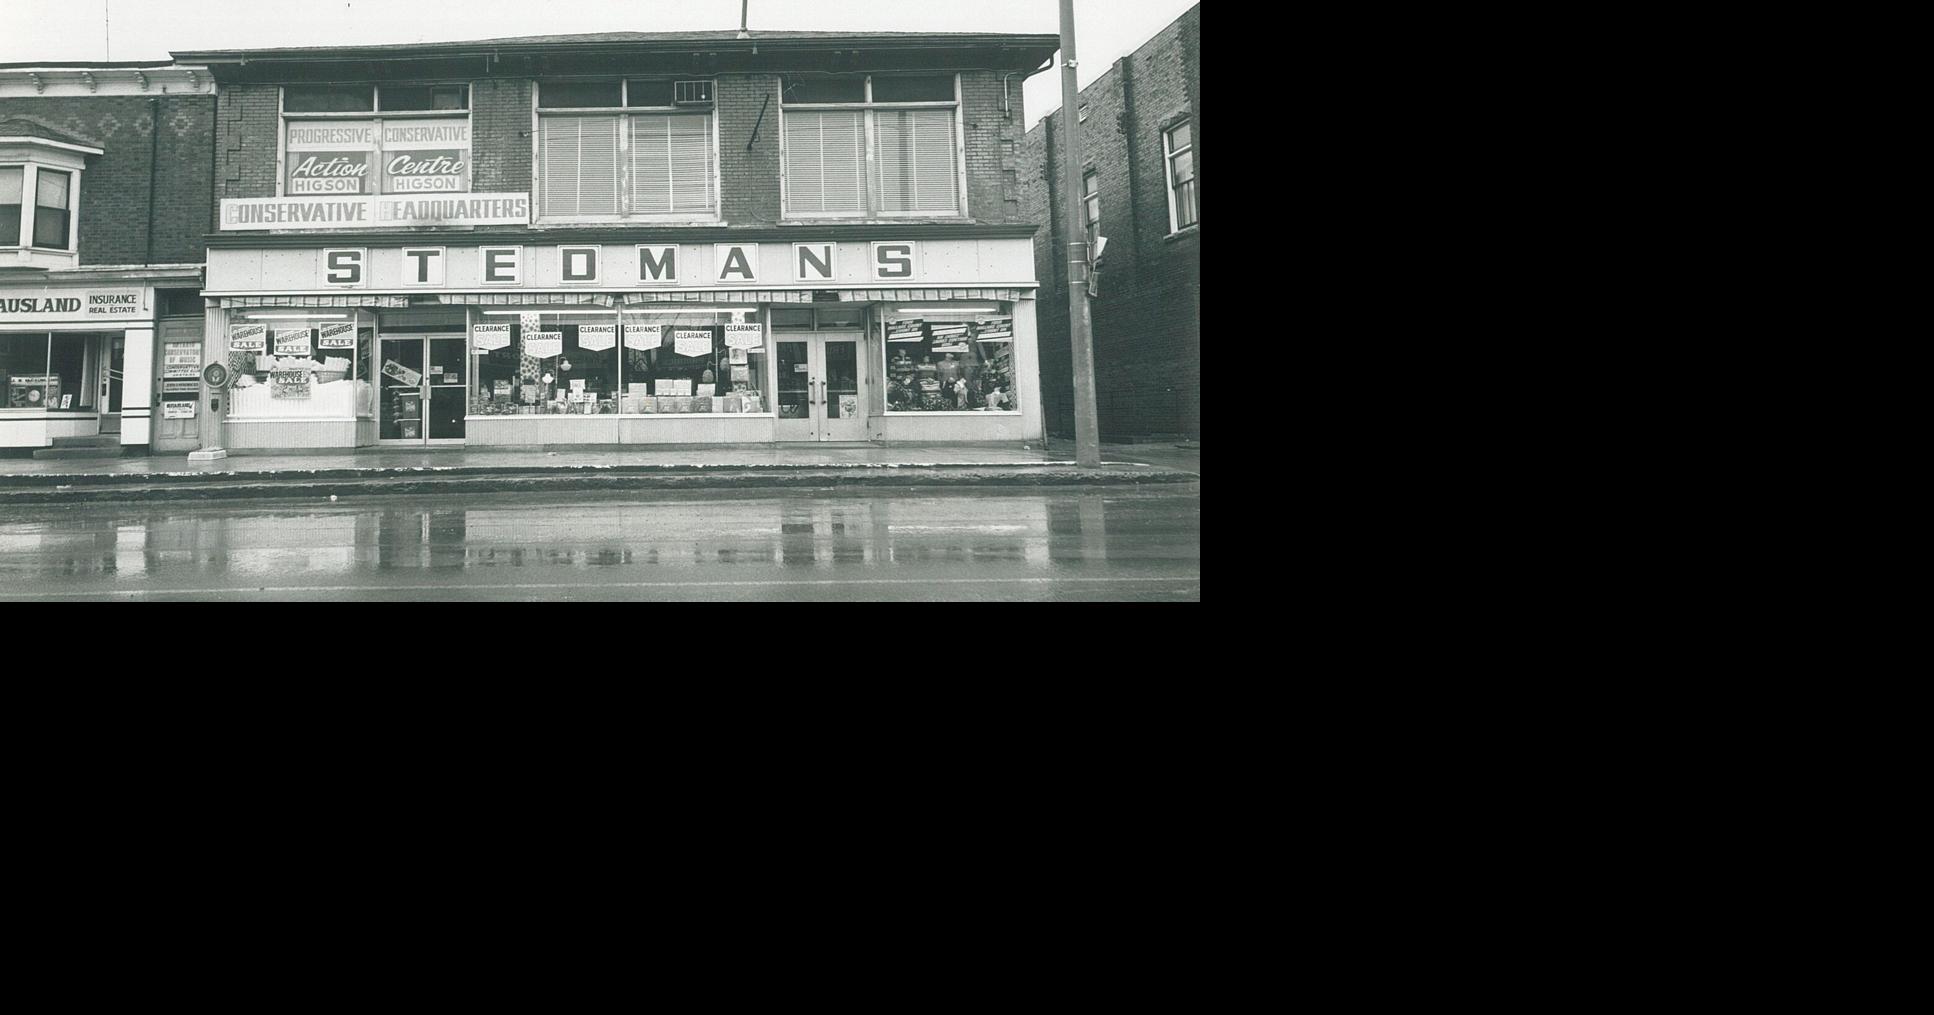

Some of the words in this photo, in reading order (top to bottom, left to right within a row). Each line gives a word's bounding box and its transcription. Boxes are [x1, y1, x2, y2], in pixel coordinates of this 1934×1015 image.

[290, 126, 372, 144] PROGRESSIVE
[384, 125, 467, 143] CONSERVATIVE
[292, 156, 369, 178] Action
[387, 154, 465, 176] Centre
[295, 178, 358, 192] HIGSON
[396, 177, 456, 190] HIGSON
[225, 202, 367, 225] CONSERVATIVE
[378, 198, 527, 222] HEADQUARTERS
[327, 244, 911, 283] STEDMANS
[89, 294, 136, 304] INSURANCE
[232, 326, 264, 340] WAREHOUSE
[322, 325, 353, 339] WAREHOUSE
[474, 325, 509, 333] CLEARANCE
[580, 326, 615, 334] CLEARANCE
[625, 325, 660, 333] CLEARANCE
[726, 324, 761, 332] CLEARANCE
[277, 330, 309, 344] WAREHOUSE
[526, 333, 561, 341] CLEARANCE
[675, 331, 711, 340] CLEARANCE
[322, 339, 351, 347] SALE
